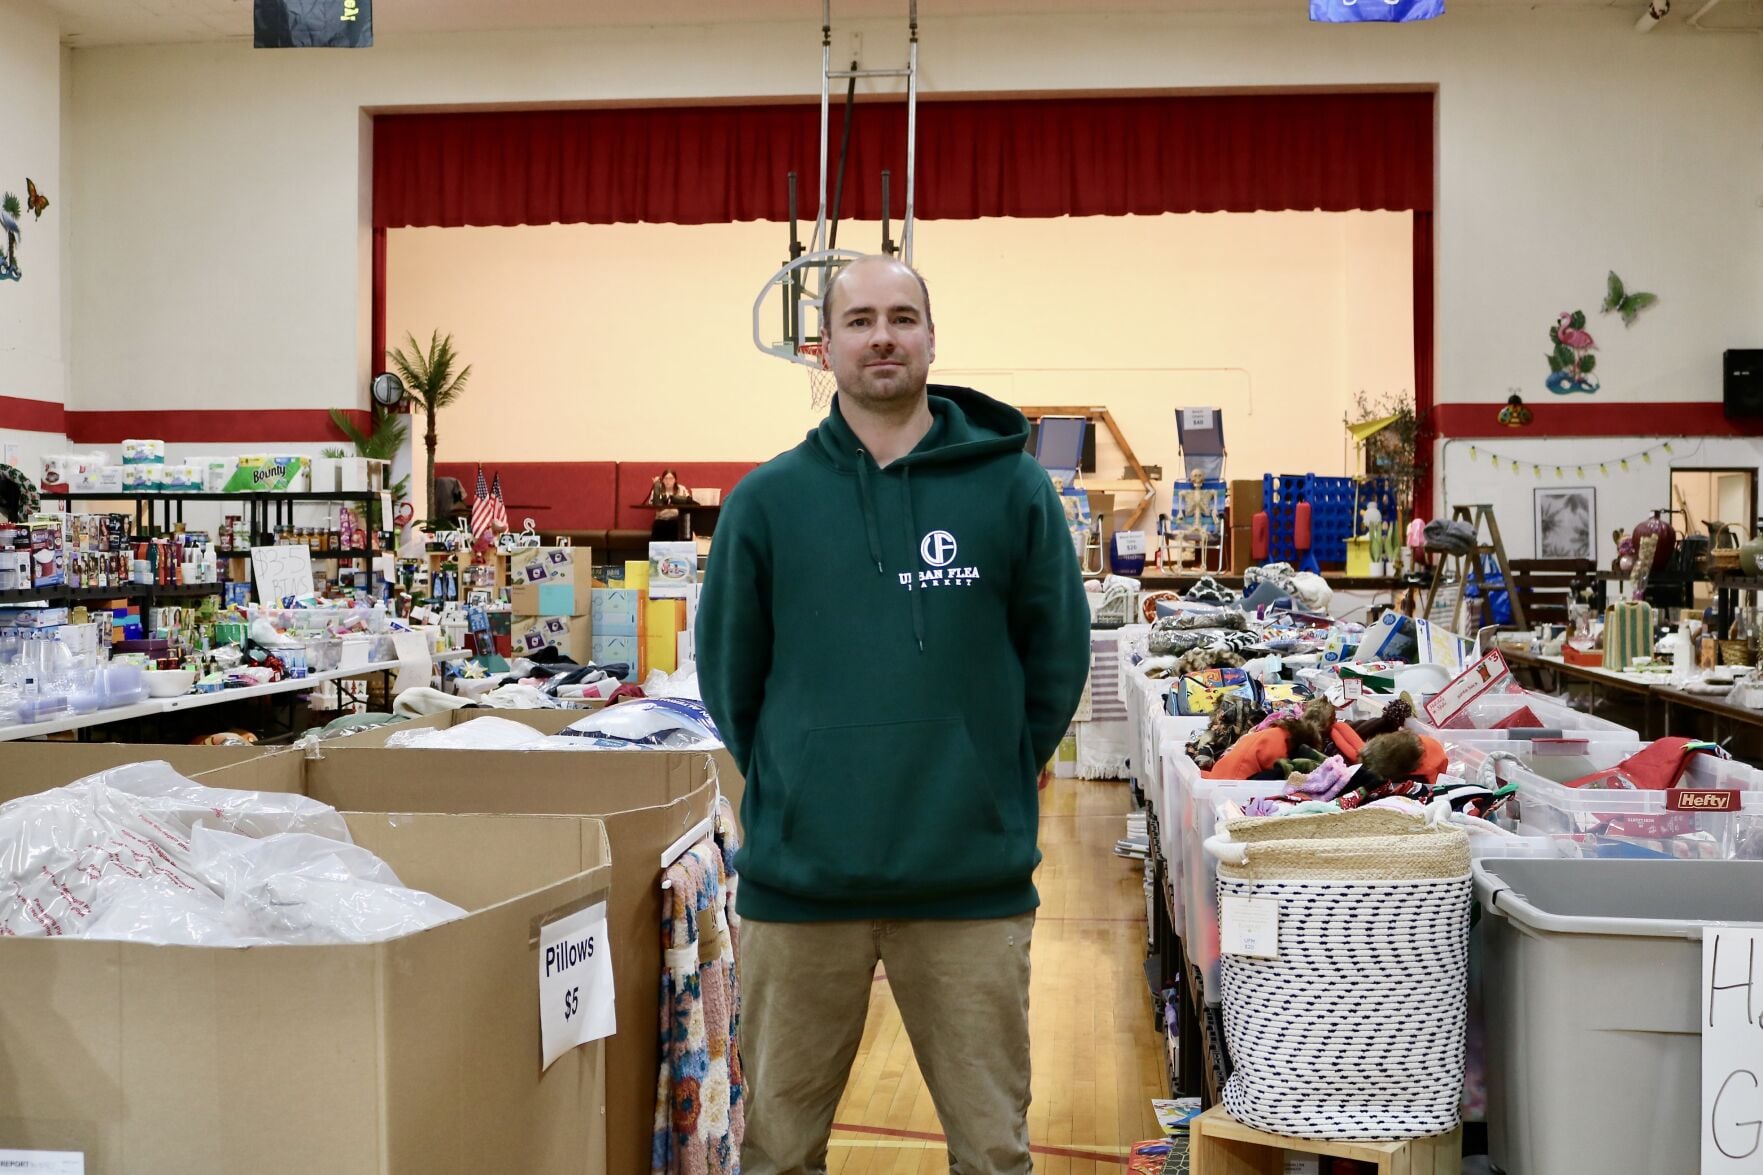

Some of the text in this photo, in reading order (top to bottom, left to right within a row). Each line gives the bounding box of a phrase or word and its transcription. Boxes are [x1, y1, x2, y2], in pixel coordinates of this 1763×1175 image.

[253, 465, 286, 484] Bounty
[898, 566, 980, 585] UBAN FLEA
[1682, 794, 1727, 808] Hefty
[545, 936, 594, 978] Pillows
[564, 987, 579, 1022] $5
